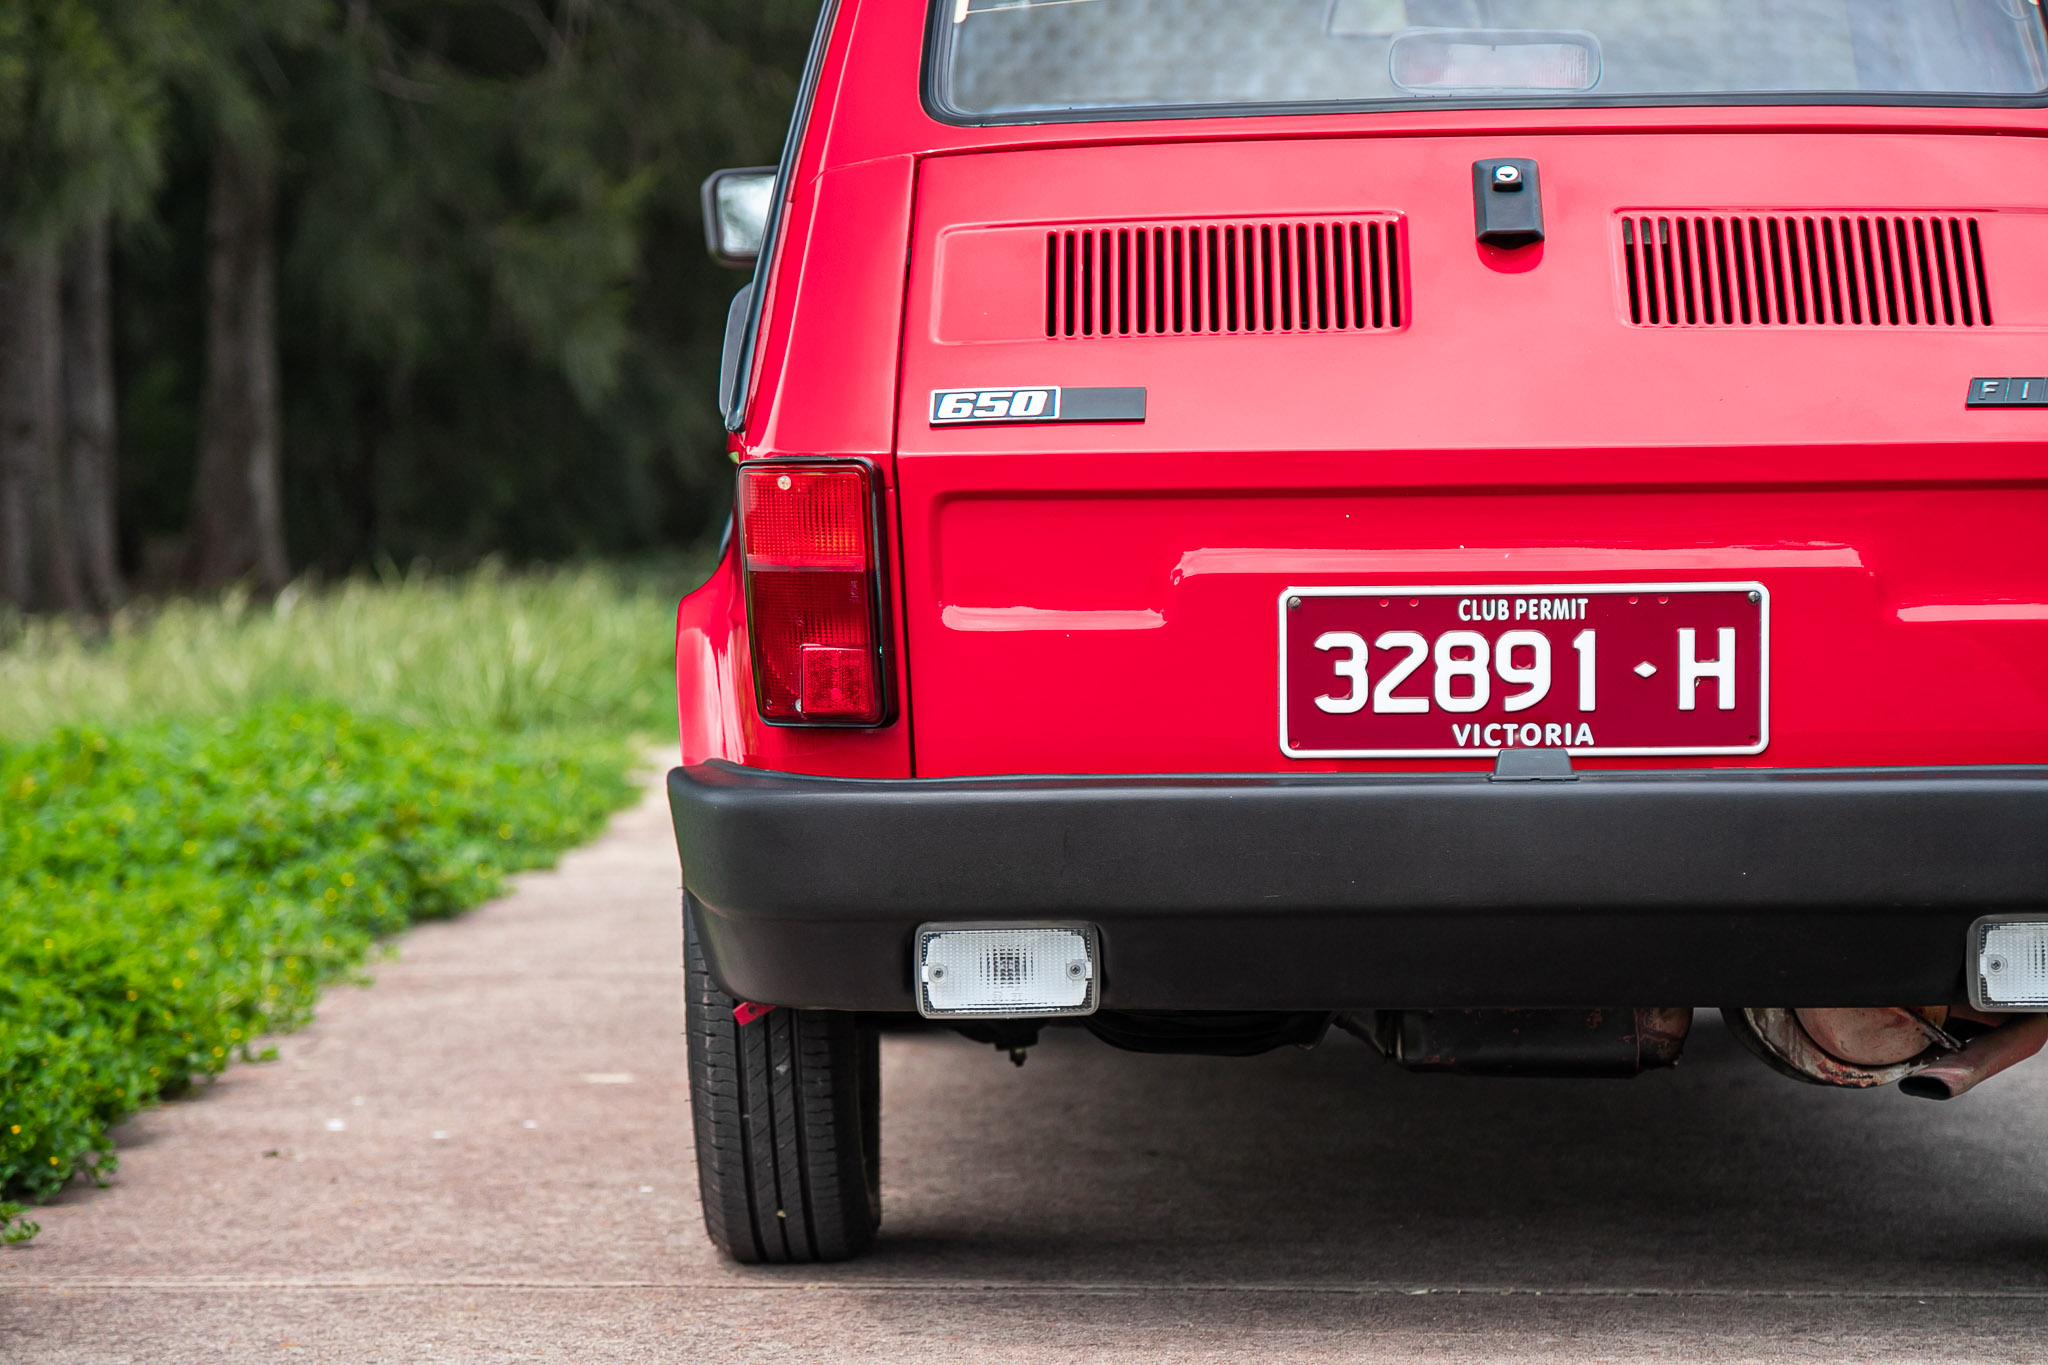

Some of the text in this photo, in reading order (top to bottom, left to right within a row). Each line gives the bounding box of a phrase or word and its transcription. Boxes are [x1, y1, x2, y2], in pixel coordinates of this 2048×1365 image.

[937, 390, 1049, 419] 650
[1458, 598, 1589, 621] CLUB PERMIT
[1313, 626, 1736, 715] 32891 H
[1451, 722, 1595, 747] VICTORIA
